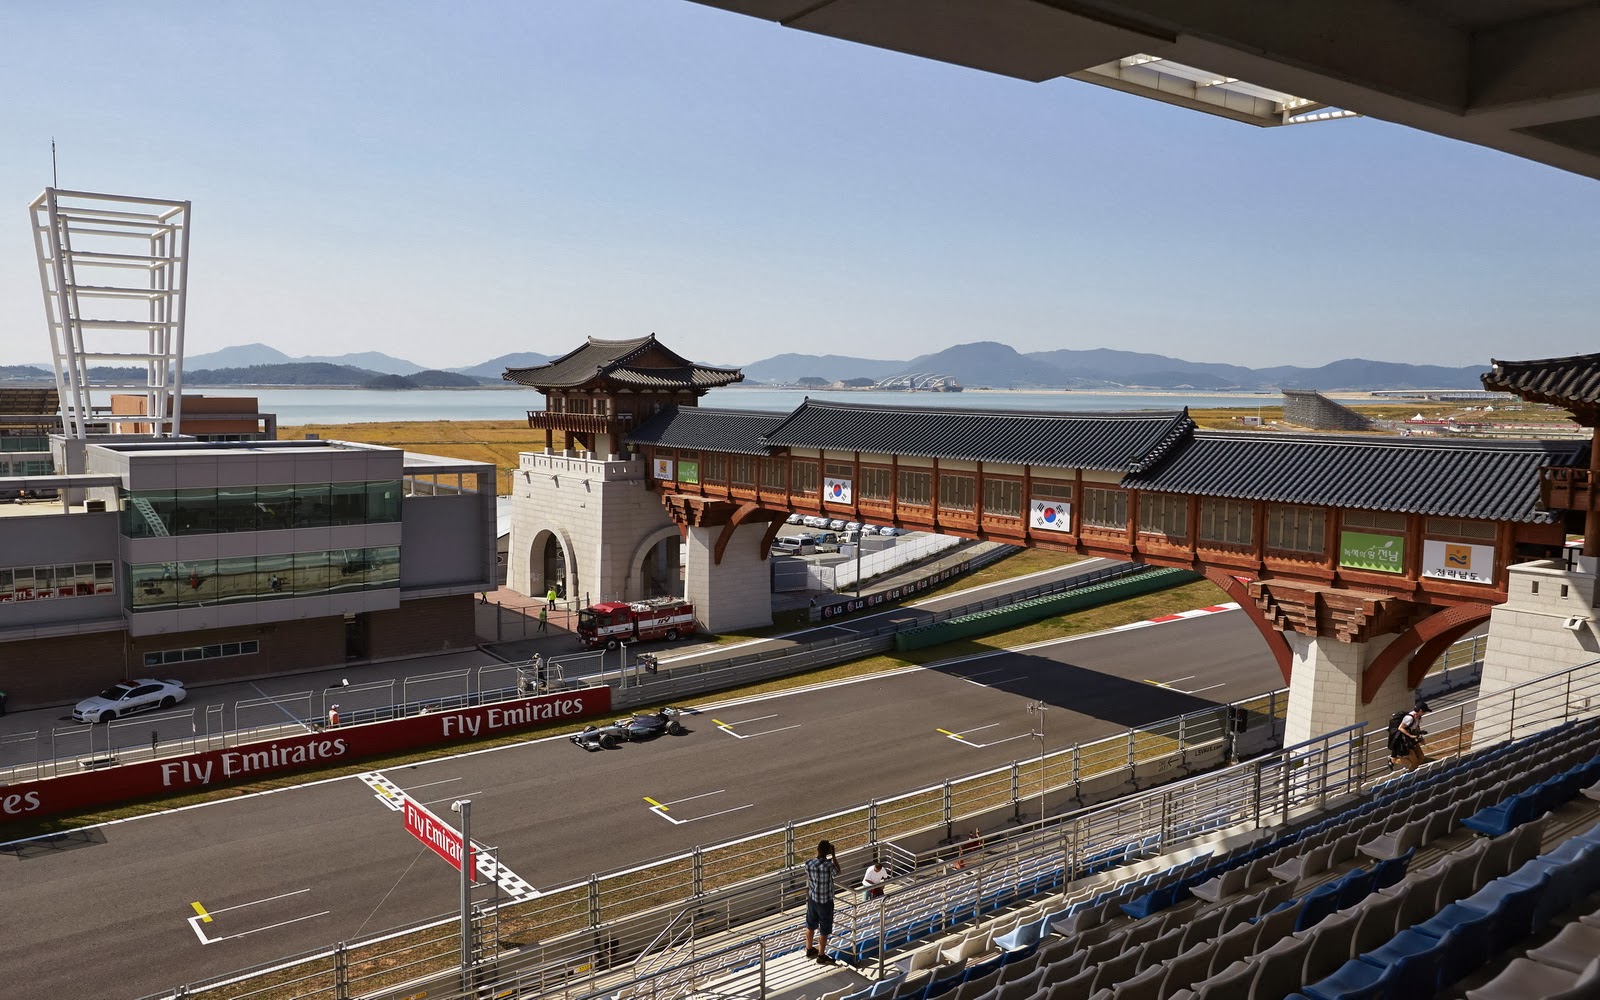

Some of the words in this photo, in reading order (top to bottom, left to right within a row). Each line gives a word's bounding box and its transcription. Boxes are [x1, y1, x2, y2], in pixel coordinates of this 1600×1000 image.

[1378, 549, 1399, 562] 전남
[1435, 568, 1479, 581] 전라남도
[892, 590, 900, 598] LG
[908, 585, 914, 593] LG
[855, 601, 864, 609] LG
[875, 595, 883, 604] LG
[833, 605, 843, 614] LG
[441, 714, 481, 736] Fly
[487, 698, 583, 729] Emirates
[160, 760, 213, 787] Fly
[221, 738, 346, 776] Emirates
[407, 804, 424, 837] Fly
[425, 817, 463, 862] Emirat
